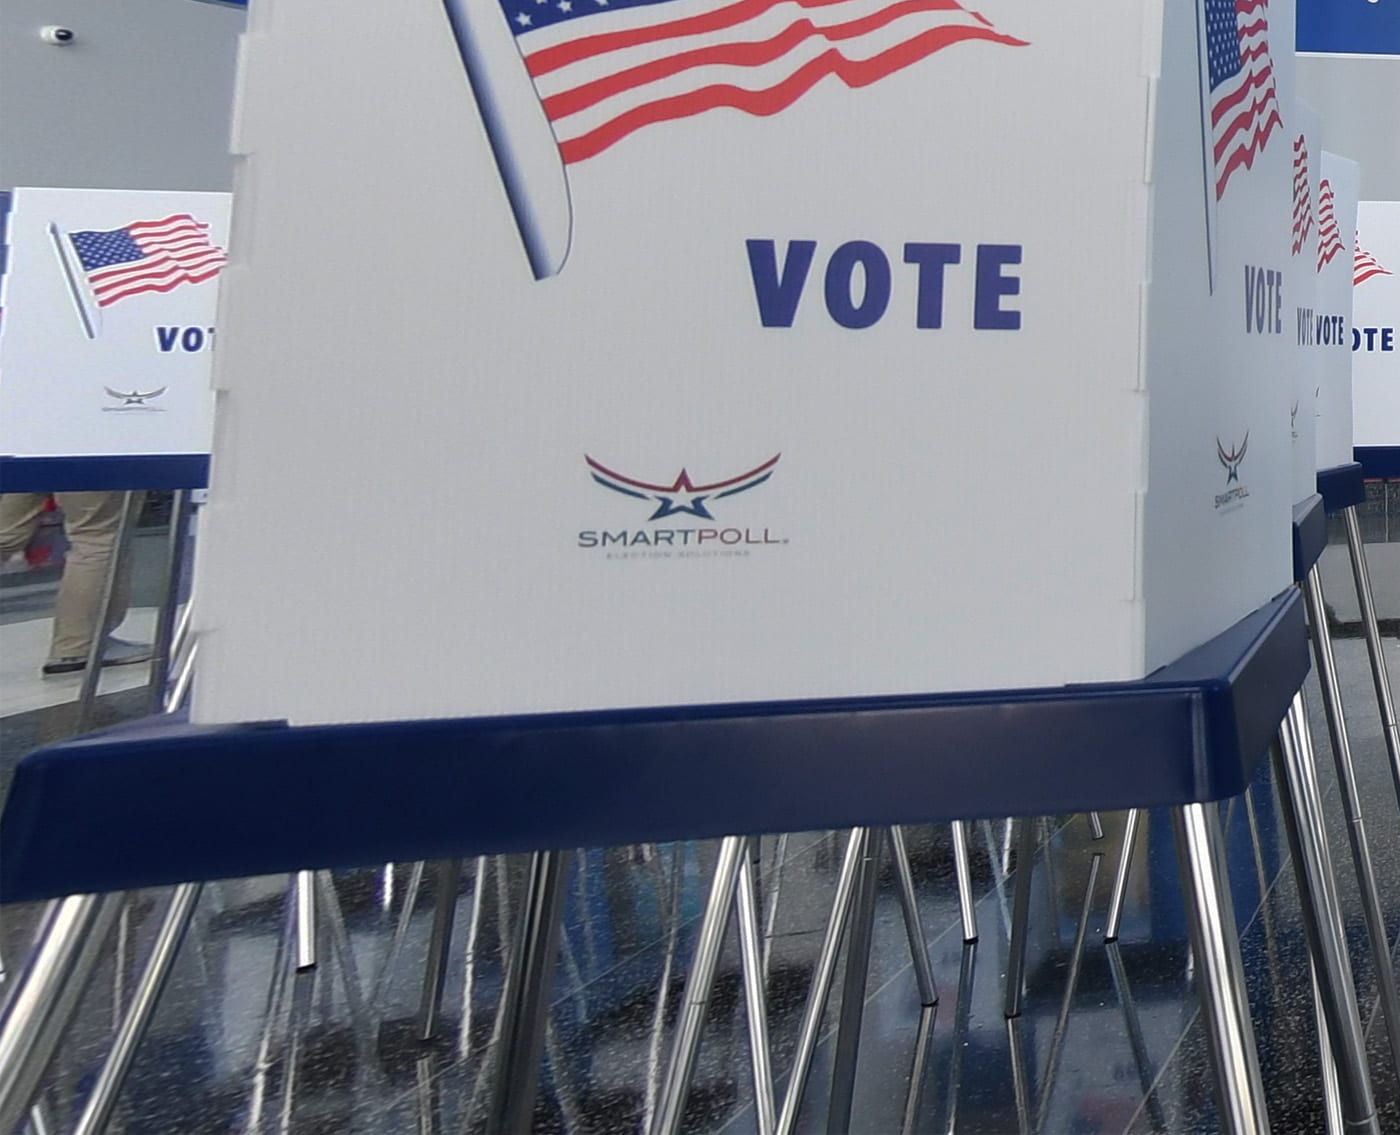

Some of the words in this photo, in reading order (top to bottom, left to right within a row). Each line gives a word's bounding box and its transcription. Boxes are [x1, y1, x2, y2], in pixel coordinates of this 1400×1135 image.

[745, 239, 1022, 330] VOTE
[1244, 264, 1282, 334] VOTE
[156, 327, 215, 352] VO
[1316, 315, 1344, 345] VOTE
[1352, 328, 1393, 351] OTE
[578, 527, 782, 548] SMARTPOLL
